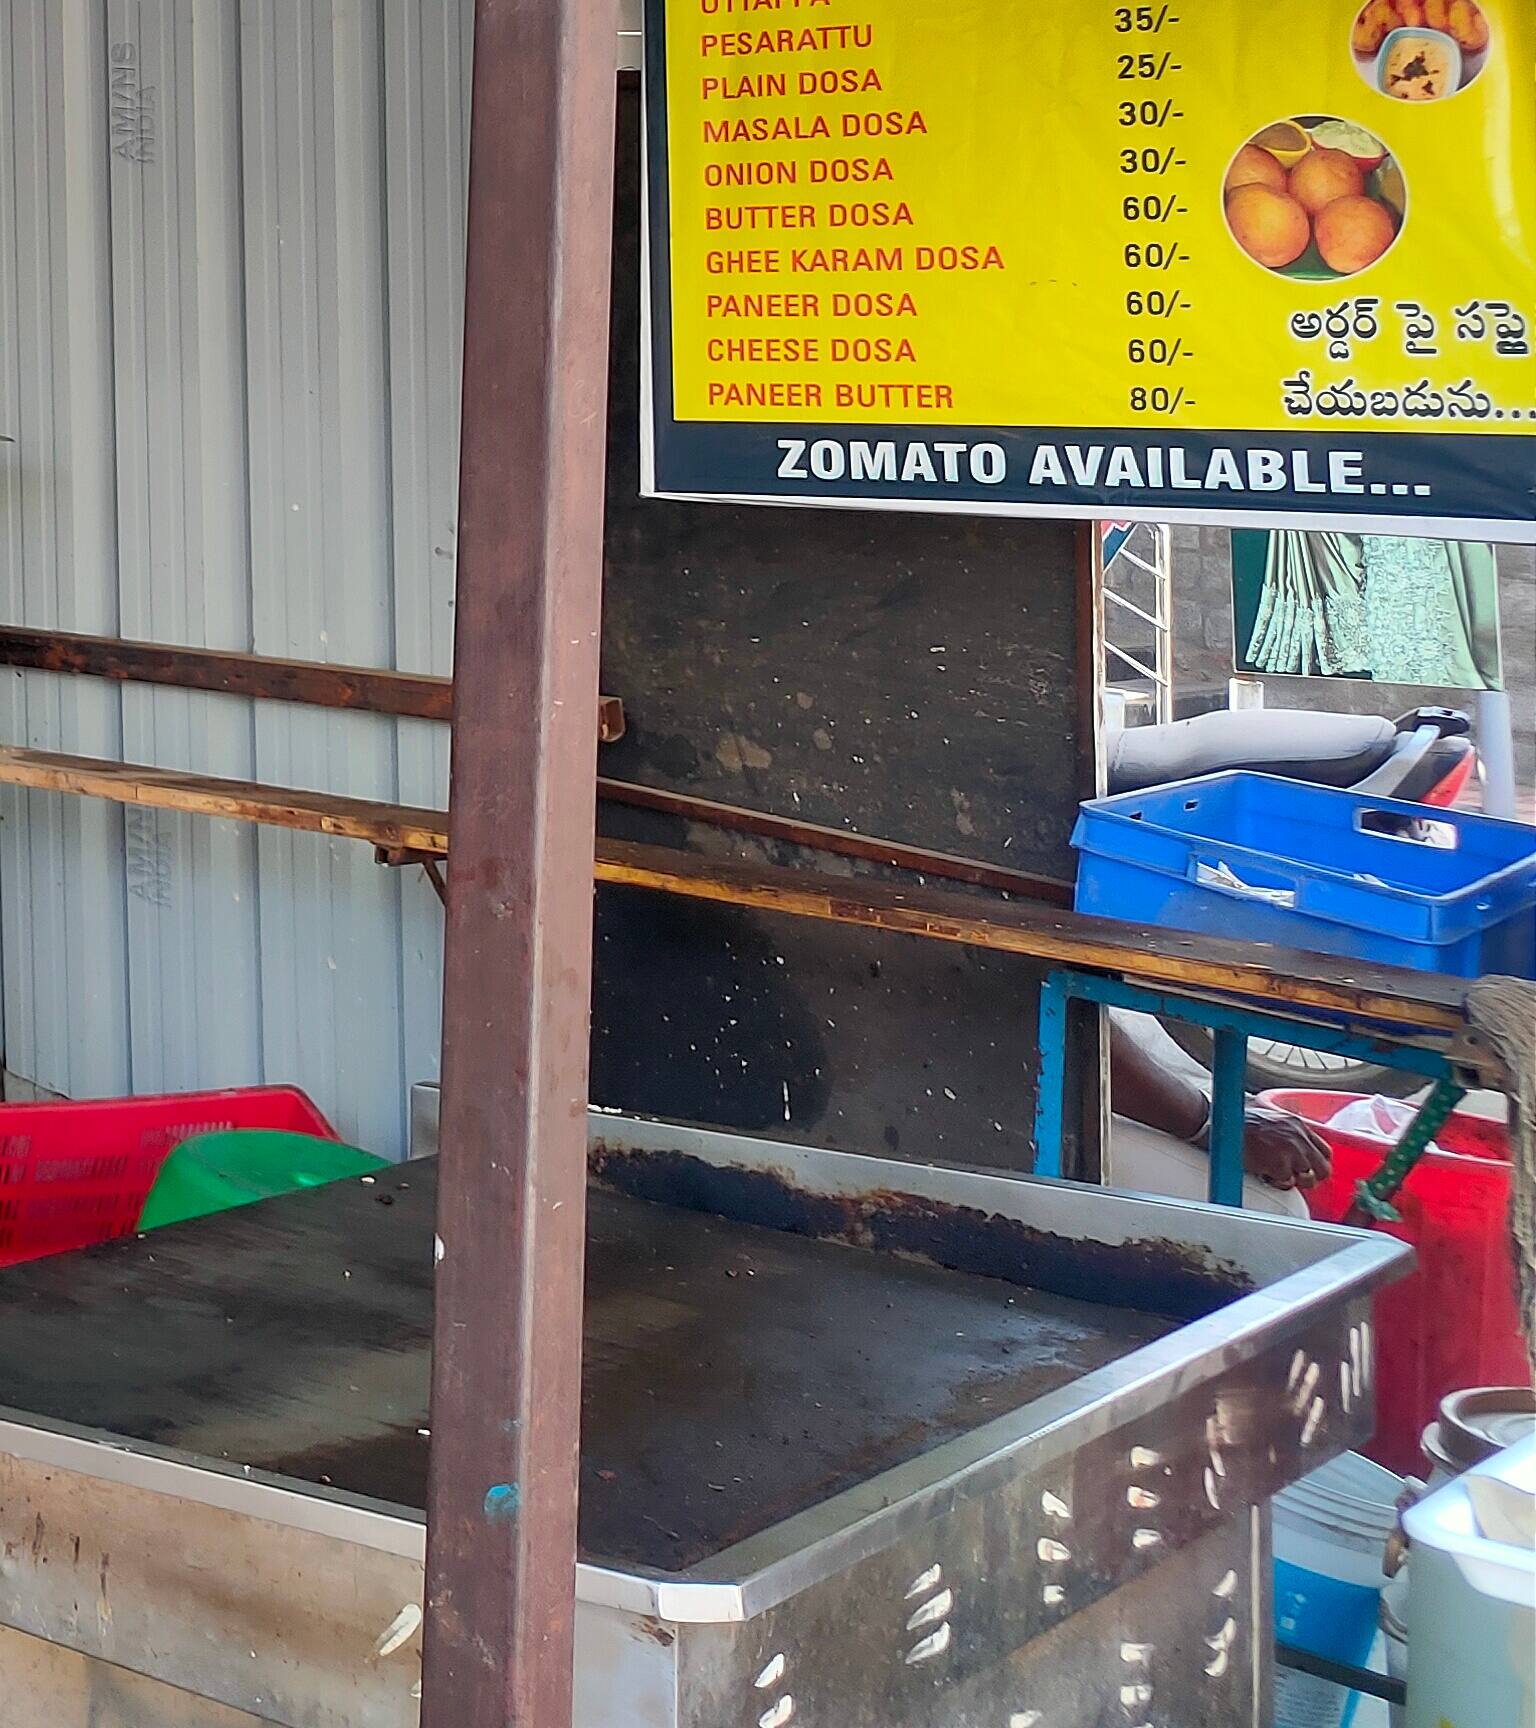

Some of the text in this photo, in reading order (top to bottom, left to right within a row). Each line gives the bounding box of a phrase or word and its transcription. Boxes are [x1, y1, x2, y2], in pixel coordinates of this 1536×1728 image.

[700, 4, 1181, 58] PESARATTU 35/-
[702, 52, 1183, 101] PLAIN DOSA 25/-
[703, 99, 1185, 144] MASALA DOSA 30/-
[704, 147, 1187, 188] ONION DOSA 30/-
[704, 195, 1188, 232] BUTTER DOSA 60/-
[705, 242, 1190, 275] GHEE KARAM DOSA 60/-
[706, 290, 1192, 320] PANEER DOSA 60/-
[1395, 303, 1437, 354] పై
[707, 337, 1194, 366] CHEESE DOSA 60/-
[708, 382, 1196, 414] PANEER BUTTER 80/-
[777, 439, 1431, 496] ZOMATO AVAILABLE...
